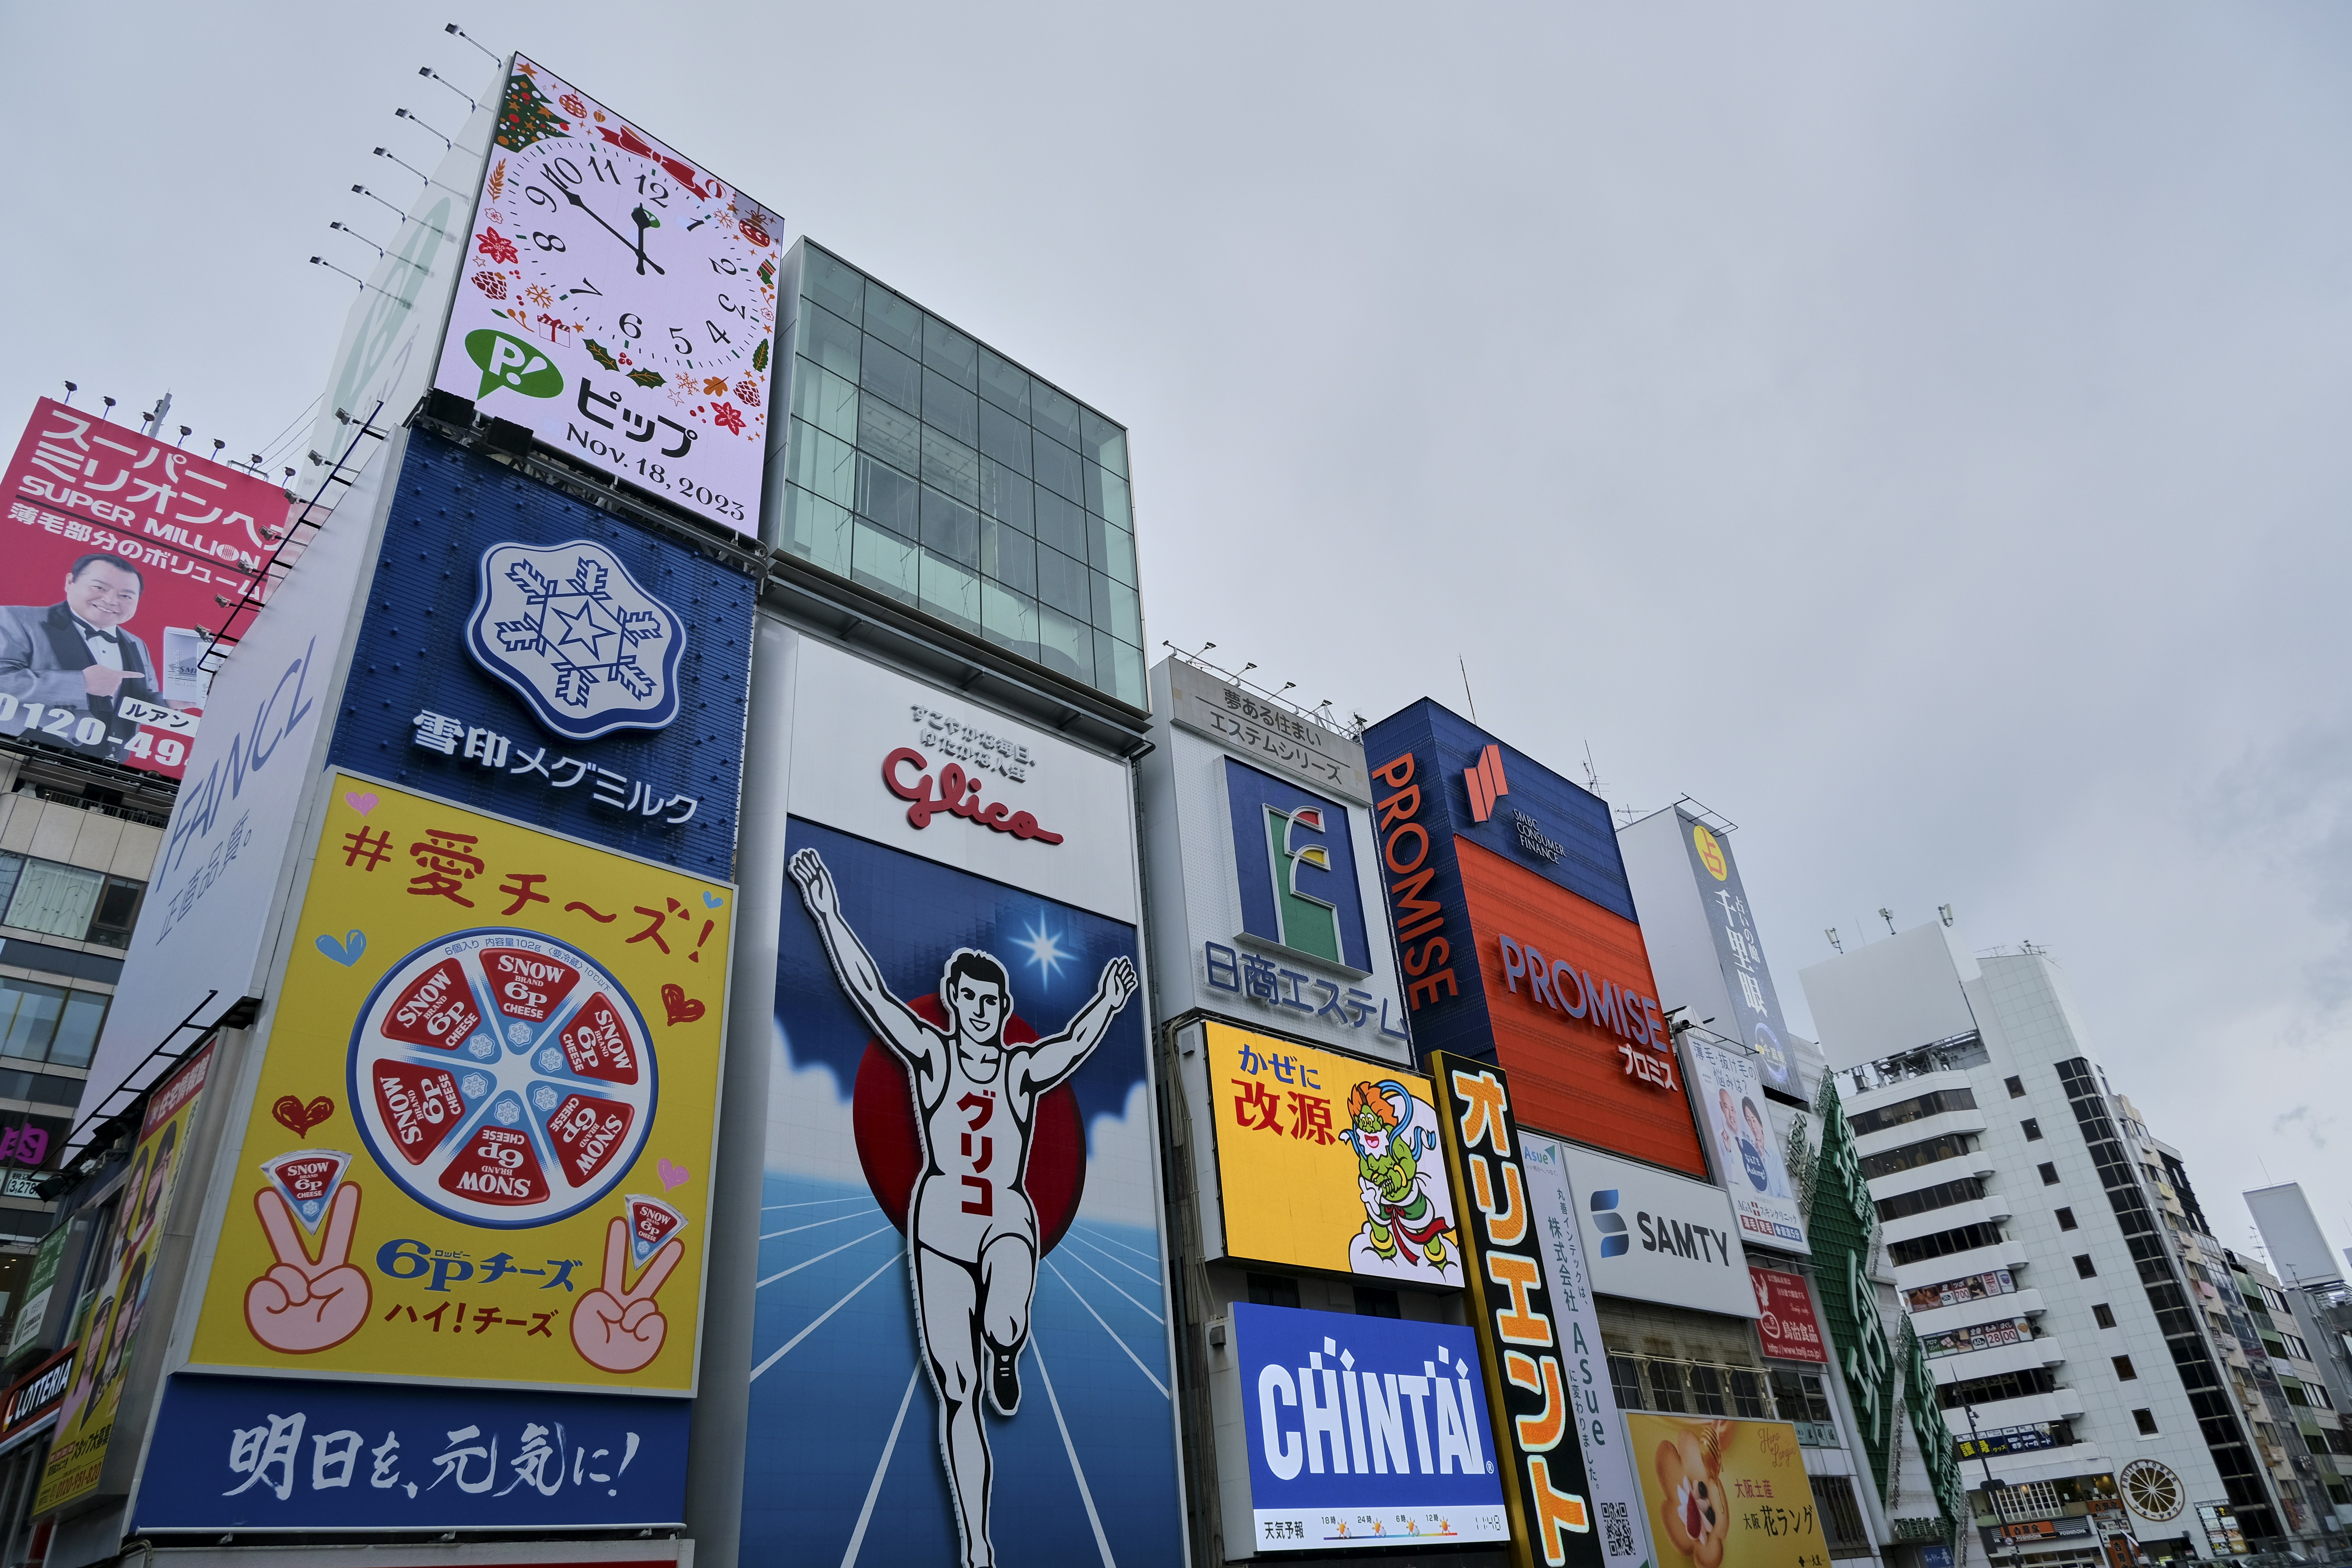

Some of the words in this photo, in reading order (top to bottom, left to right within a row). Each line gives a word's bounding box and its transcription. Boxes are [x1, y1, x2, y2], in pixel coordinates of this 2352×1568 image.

[540, 158, 582, 189] 10
[588, 156, 620, 185] 11
[526, 186, 557, 213] 9
[634, 174, 668, 208] 12
[533, 231, 566, 252] 8
[686, 218, 704, 232] 1
[708, 257, 737, 276] 2
[570, 278, 602, 296] 7
[718, 294, 745, 319] 3
[619, 313, 642, 338] 6
[669, 328, 692, 354] 5
[706, 320, 730, 345] 4
[577, 377, 698, 458] ピップ
[41, 409, 227, 489] スーパー
[567, 423, 628, 468] Nov.
[637, 458, 671, 490] 18,
[679, 478, 744, 521] 2023
[19, 475, 135, 526] SUPER
[144, 522, 260, 570] MILLION
[7, 502, 260, 600] 薄毛部分のボリューム
[0, 693, 188, 766] 0120-49
[126, 704, 189, 727] ルアン
[1223, 688, 1321, 746] 夢ある住まい
[911, 704, 1037, 767] すこやかな毎日、
[1210, 711, 1342, 785] エステムシリーズ
[156, 634, 316, 893] FANCL
[413, 709, 697, 823] 雪印メグミルク
[922, 728, 1026, 783] ゆたかな人生
[883, 747, 1064, 845] Glico
[1514, 809, 1539, 831] SMBC
[1517, 822, 1566, 858] CONSUMER
[1519, 835, 1559, 864] FINANCE
[1701, 828, 1724, 876] 占
[1372, 752, 1458, 1011] PROMISE
[444, 940, 479, 956] 6個入り
[485, 937, 542, 953] 内容量102g
[1735, 897, 1760, 964] 占いの館
[498, 955, 565, 983] SNOW
[1714, 889, 1767, 1018] 千里眼
[396, 968, 452, 1027] SNOW
[505, 982, 548, 1007] 6P
[515, 975, 544, 987] BRAND
[1206, 941, 1410, 1041] 日商エステム
[1499, 934, 1668, 1052] PROMISE
[423, 995, 447, 1019] BRAND
[427, 1001, 466, 1036] 6P
[504, 1003, 544, 1019] CHEESE
[446, 1013, 478, 1046] CHEESE
[594, 1010, 632, 1070] SNOW
[594, 1030, 609, 1057] BRAND
[563, 1034, 584, 1072] CHEESE
[577, 1026, 599, 1068] 6P
[1238, 1044, 1321, 1089] かぜに
[1618, 1043, 1678, 1091] プロミス
[380, 1076, 423, 1145] SNOW
[407, 1090, 424, 1121] BRAND
[421, 1078, 444, 1124] 6P
[438, 1073, 461, 1115] CHEESE
[550, 1098, 579, 1132] CHEESE
[563, 1108, 596, 1144] 6P
[1231, 1078, 1336, 1145] 改源
[482, 1130, 525, 1145] CHEESE
[575, 1114, 622, 1176] SNOW
[580, 1124, 600, 1148] BRAND
[957, 1089, 996, 1217] グリコ
[288, 1162, 329, 1176] SNOW
[478, 1142, 524, 1168] 6P
[482, 1165, 513, 1176] BRAND
[1524, 1146, 1548, 1165] Asue
[295, 1179, 322, 1190] 6P
[297, 1190, 322, 1199] CHEESE
[456, 1171, 531, 1197] SNOW
[640, 1207, 671, 1225] SNOW
[640, 1221, 660, 1235] 6P
[1738, 1200, 1753, 1213] AGA
[1760, 1207, 1796, 1224] スキンクリニック
[639, 1231, 657, 1242] CHEESE
[1637, 1211, 1730, 1267] SAMTY
[1548, 1216, 1579, 1312] 株式会社
[1452, 1069, 1590, 1567] オリエント
[15, 1358, 72, 1420] LOTTERIA
[1258, 1336, 1485, 1480] CHINTAI
[1569, 1369, 1599, 1489] に変わりました。
[1735, 1479, 1774, 1499] 大阪土産
[2122, 1462, 2139, 1488] FRUITS
[2145, 1461, 2177, 1482] TOWER
[1264, 1521, 1304, 1540] 天気予報
[2014, 1524, 2040, 1535] 吉野家
